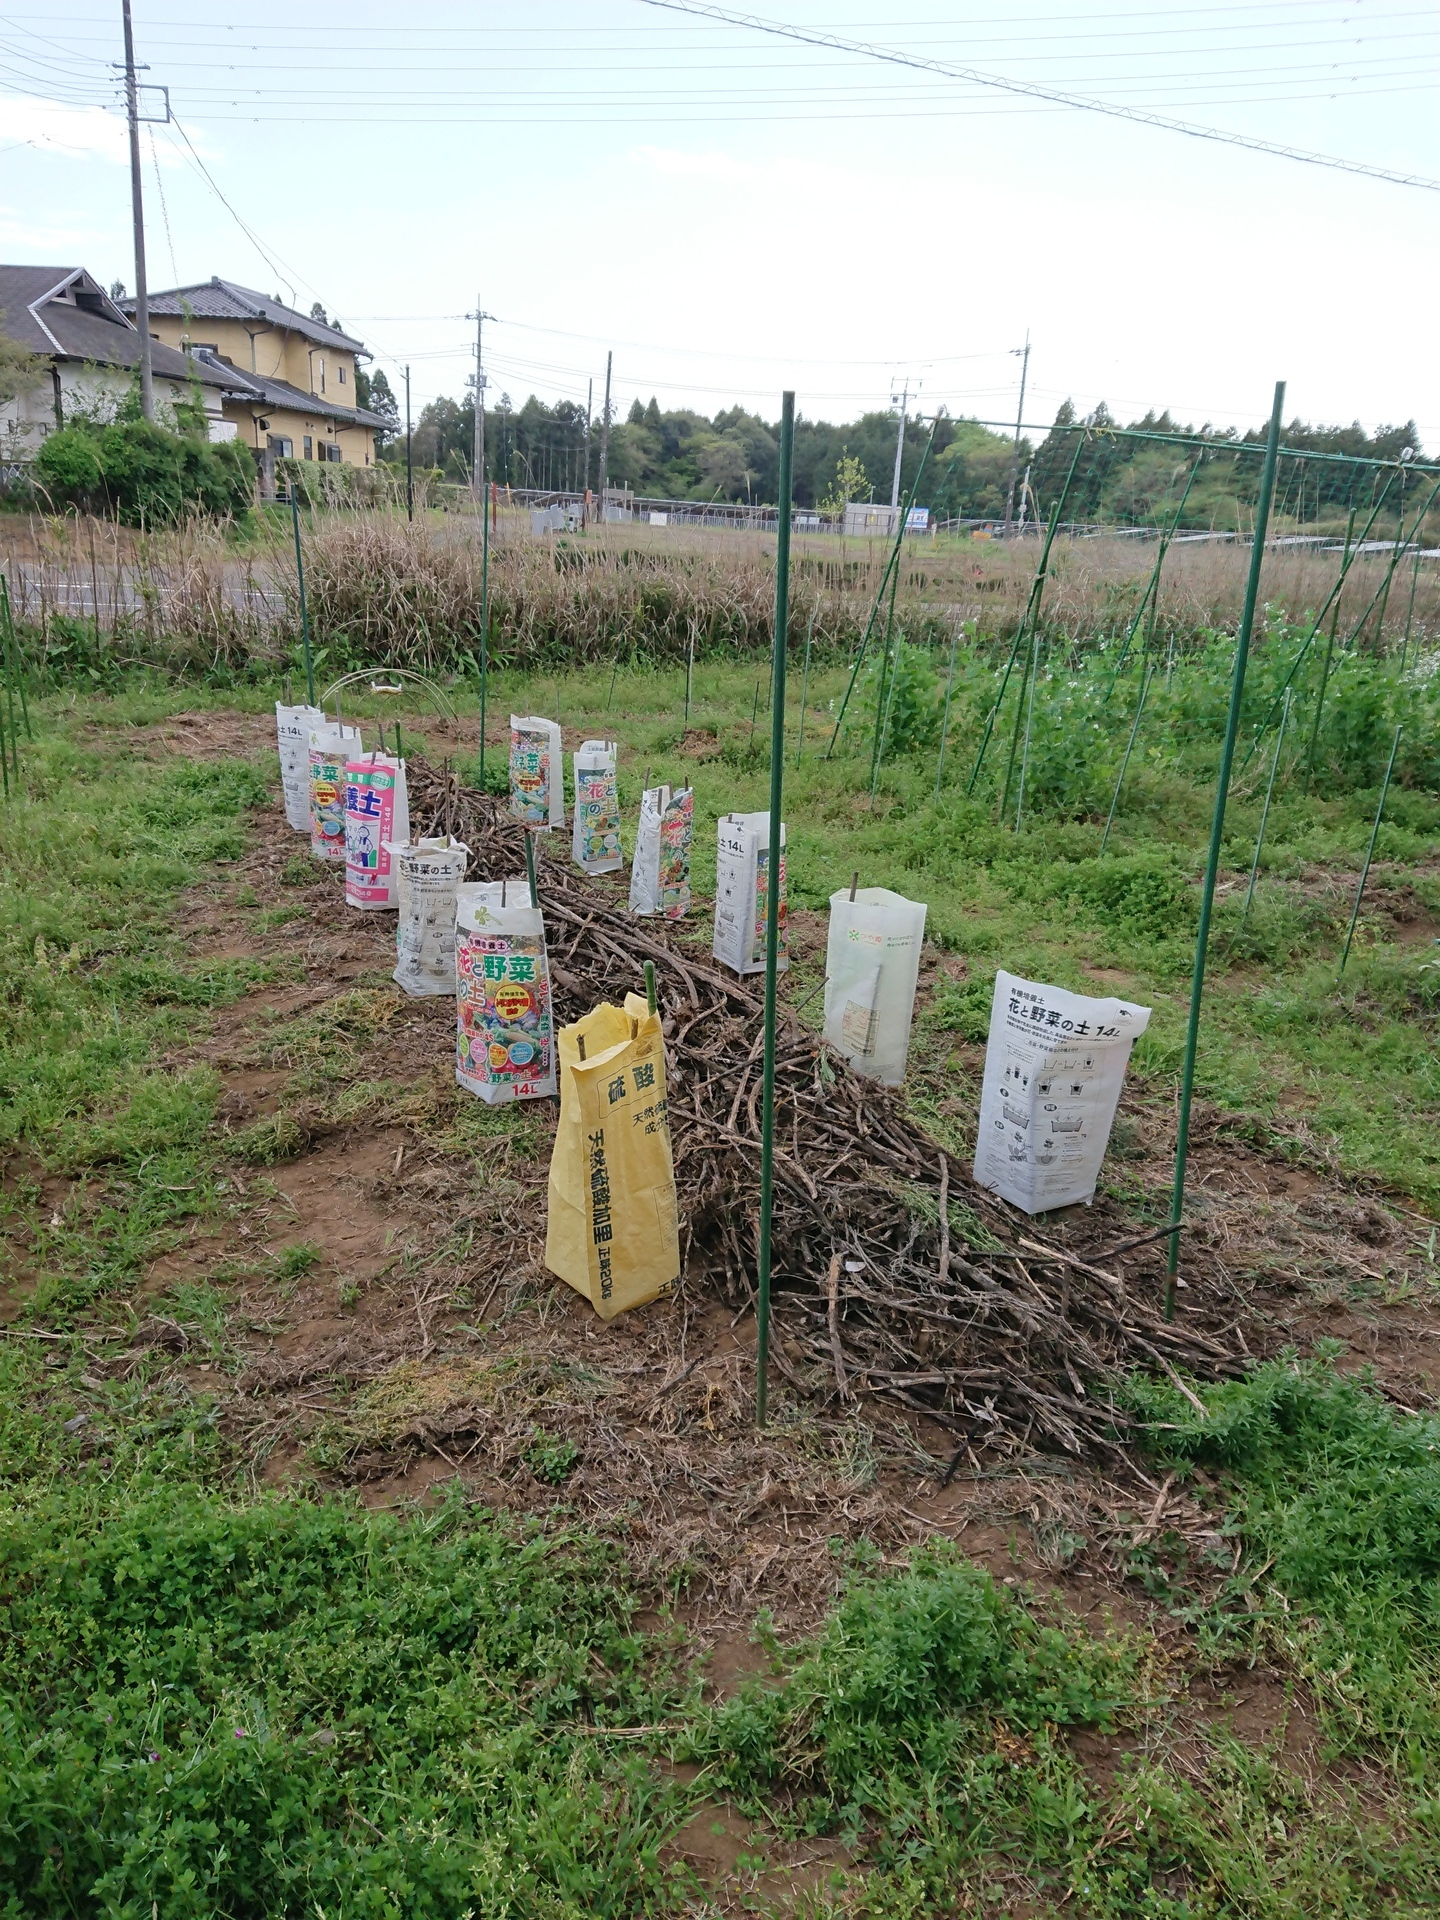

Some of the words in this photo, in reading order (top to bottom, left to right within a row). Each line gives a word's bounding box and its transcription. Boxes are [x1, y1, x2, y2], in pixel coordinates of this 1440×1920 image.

[287, 726, 303, 736] 14L
[588, 782, 614, 799] 花と
[589, 800, 616, 815] の土
[727, 839, 745, 853] 14L
[459, 946, 536, 982] 花と野菜
[460, 979, 486, 1005] の土
[1010, 987, 1046, 1005] 有機培養土
[1008, 997, 1091, 1036] 花と野菜の土
[1096, 1025, 1121, 1038] 14L
[512, 1082, 539, 1097] 14L
[608, 1062, 656, 1105] 硫酸
[588, 1128, 613, 1246] 天然硫酸加里
